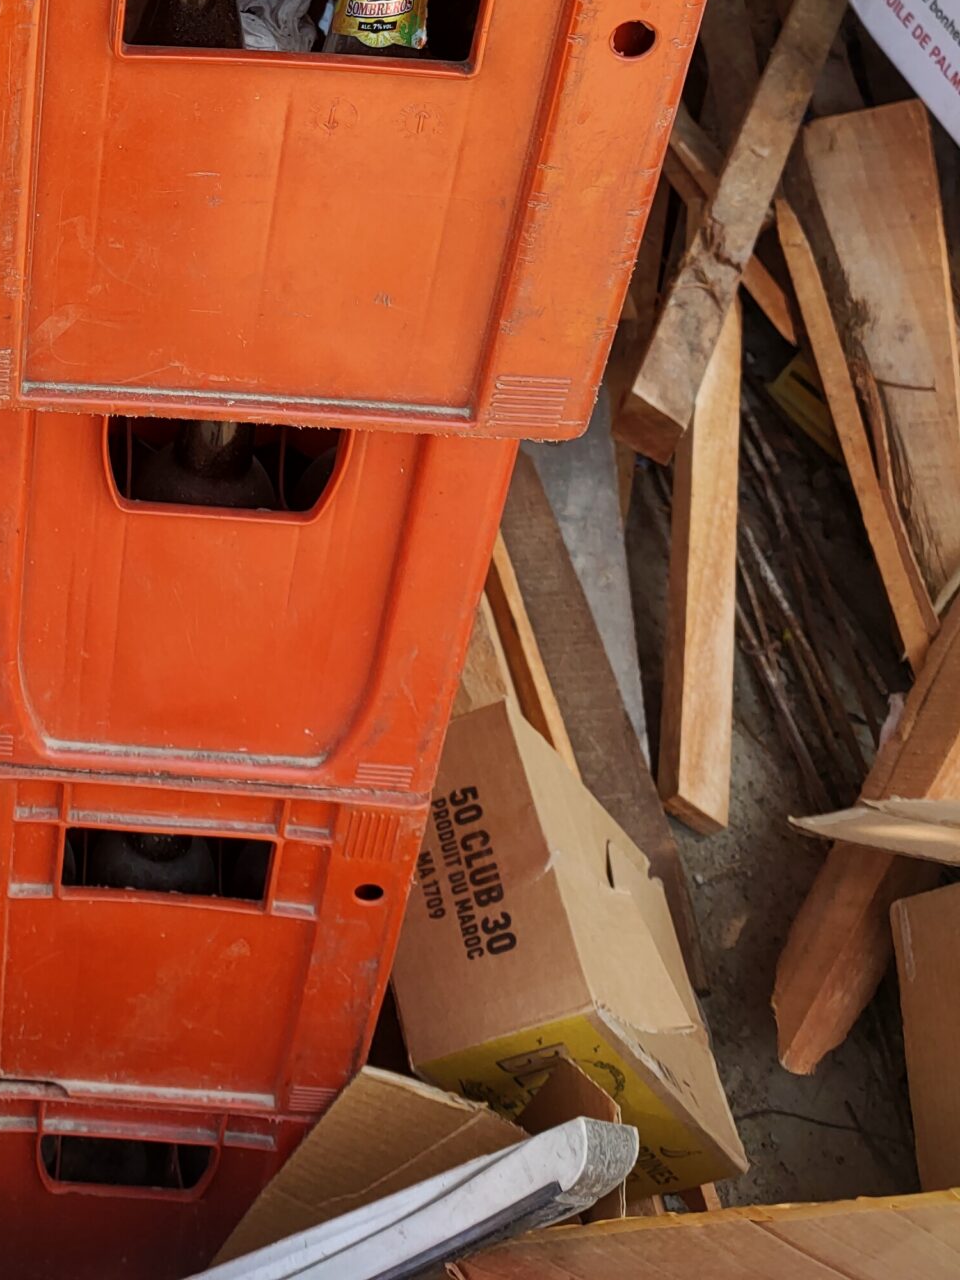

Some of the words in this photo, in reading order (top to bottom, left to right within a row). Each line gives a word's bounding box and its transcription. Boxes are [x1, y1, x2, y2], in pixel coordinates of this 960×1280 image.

[912, 23, 932, 51] DE
[928, 45, 960, 97] PALM
[449, 785, 483, 826] 50
[431, 797, 462, 868] PRODUIT
[417, 850, 436, 880] MA
[448, 870, 469, 896] DU
[460, 829, 504, 908] CLUB
[422, 879, 446, 920] 1709
[454, 897, 484, 961] MAROC
[481, 911, 517, 956] 30
